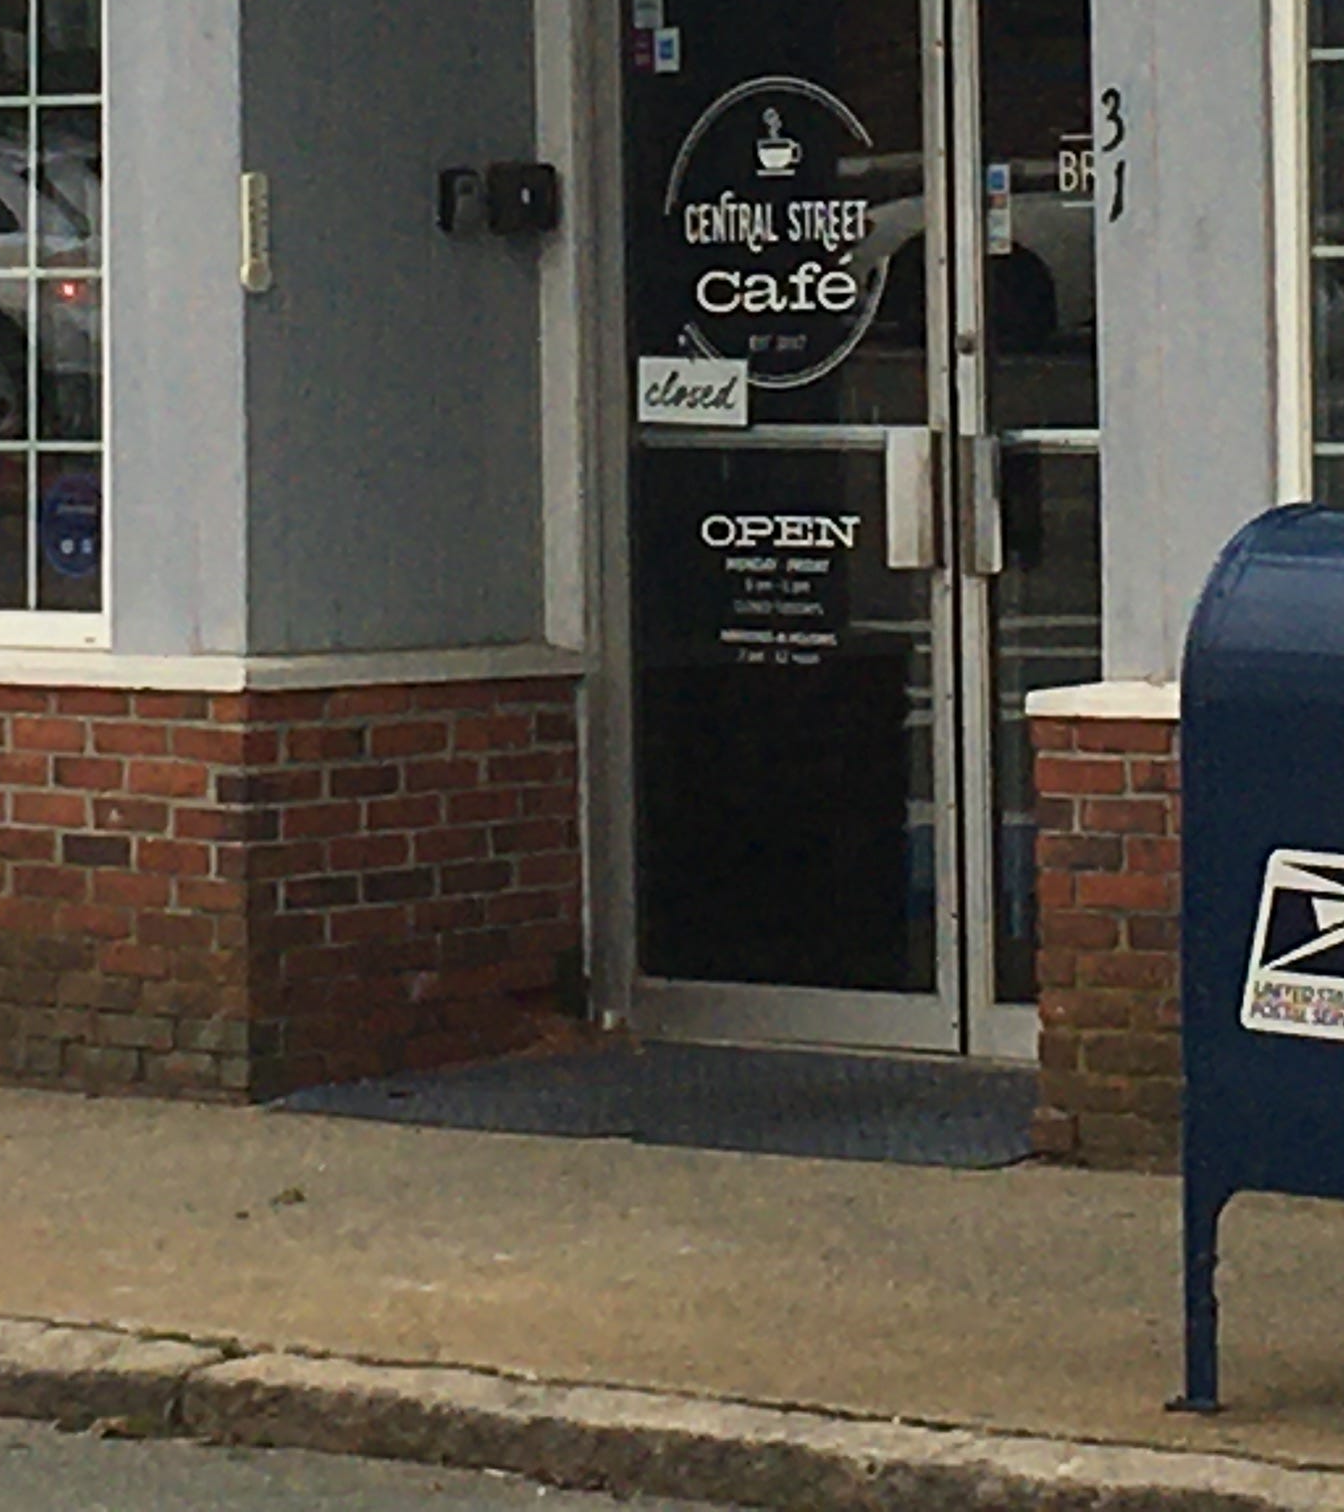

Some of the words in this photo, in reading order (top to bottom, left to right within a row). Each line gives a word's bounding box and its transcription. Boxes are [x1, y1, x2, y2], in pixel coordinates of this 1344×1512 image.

[684, 190, 778, 252] CENTRAL
[787, 200, 868, 252] STREET
[644, 371, 738, 410] closed
[701, 514, 861, 549] OPEN
